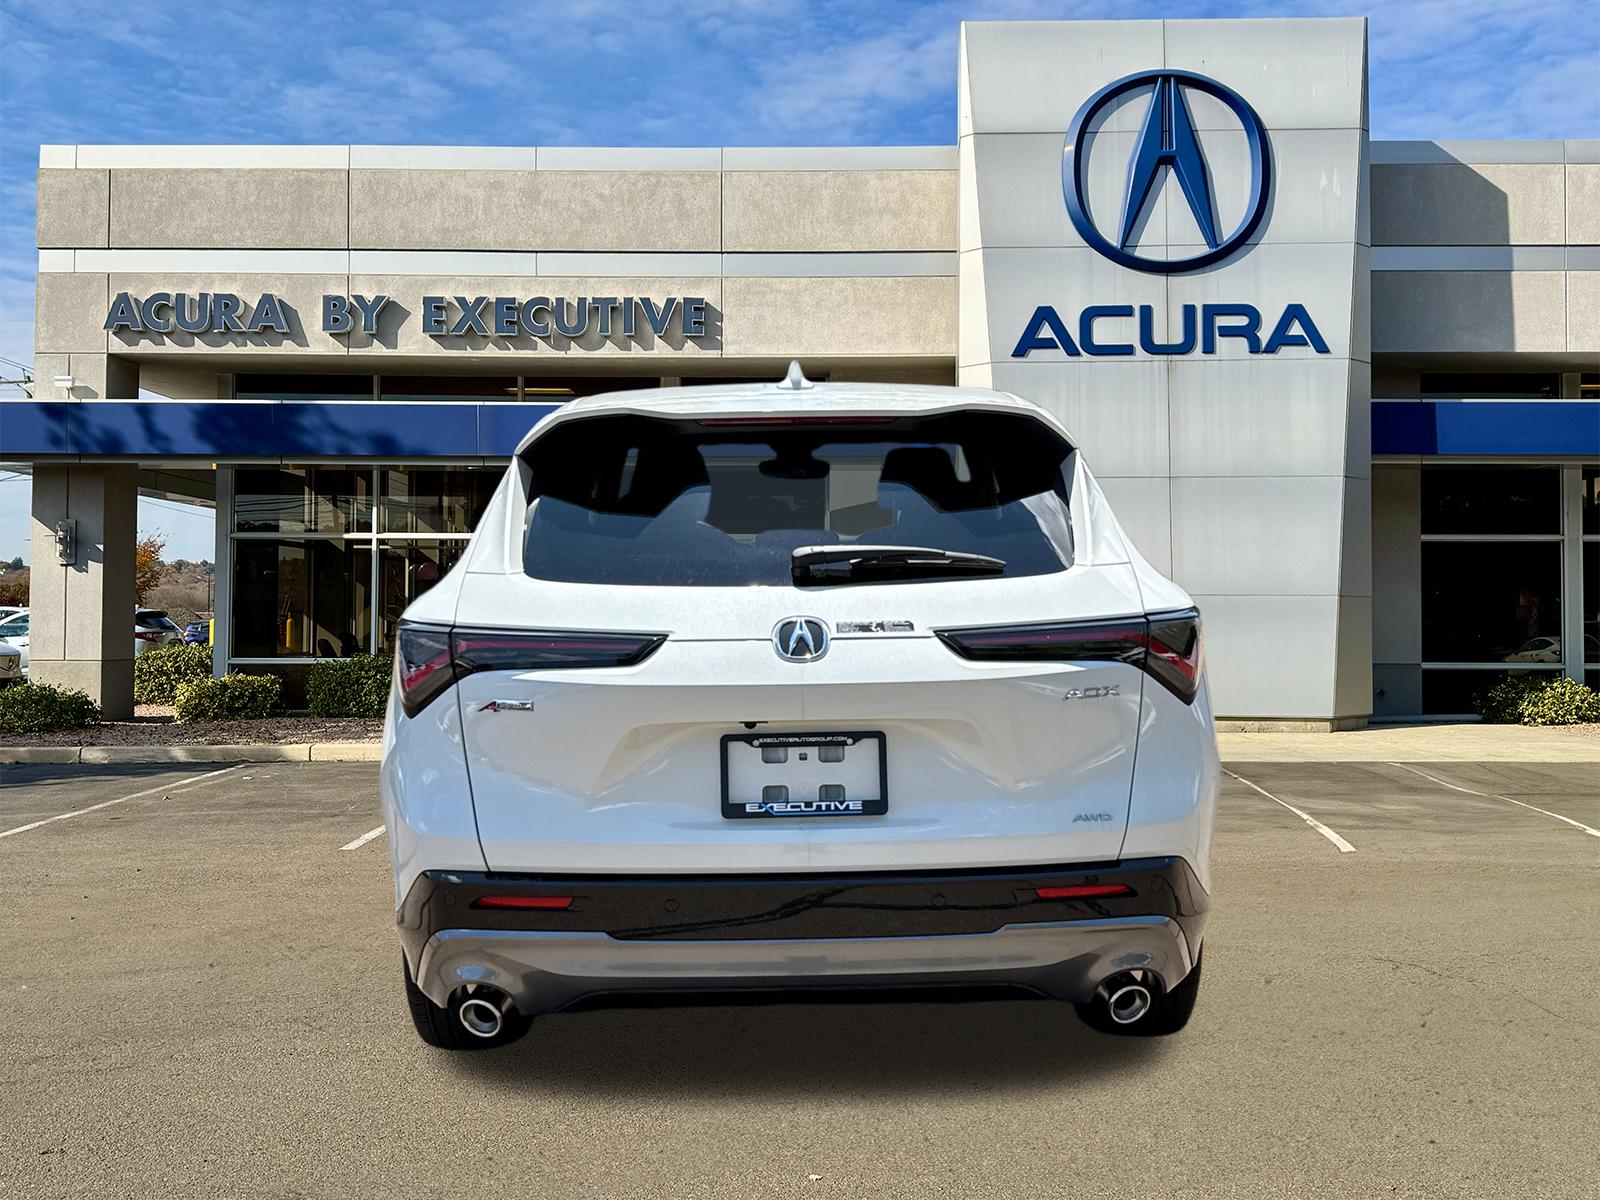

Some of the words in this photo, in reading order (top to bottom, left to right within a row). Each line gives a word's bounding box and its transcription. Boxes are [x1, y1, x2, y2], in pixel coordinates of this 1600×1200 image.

[103, 292, 290, 333] ACURA
[322, 294, 390, 334] BY
[422, 296, 706, 336] EXECUTIVE
[1011, 303, 1331, 357] ACURA
[1063, 685, 1120, 701] ADX
[745, 801, 864, 814] EXECUTIVE
[1072, 813, 1113, 823] AWD
